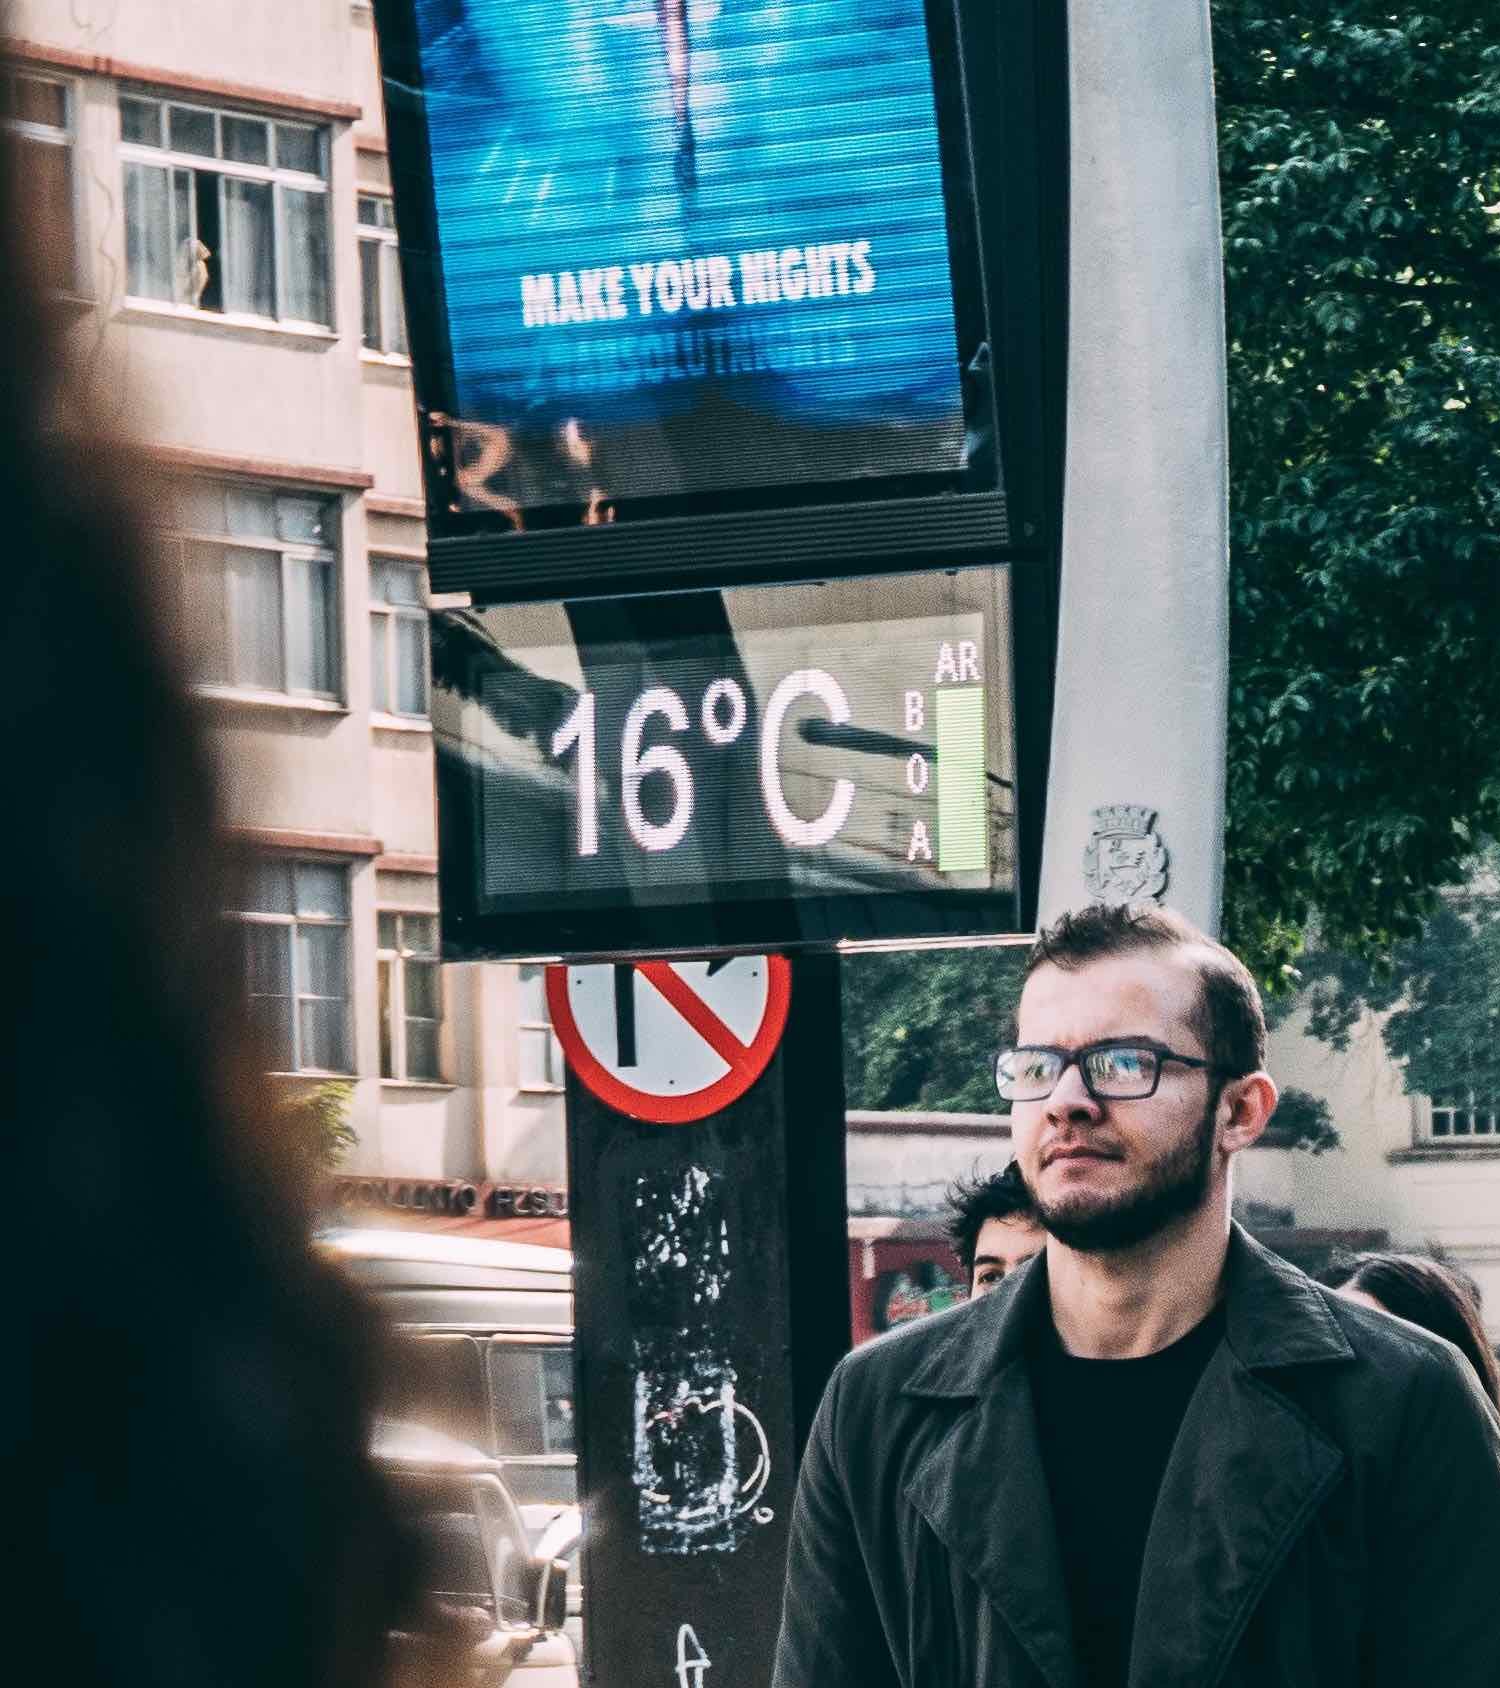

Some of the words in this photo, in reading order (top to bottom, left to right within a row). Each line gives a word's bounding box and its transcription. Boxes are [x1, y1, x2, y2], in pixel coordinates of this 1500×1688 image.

[521, 266, 628, 328] MAKE
[629, 255, 737, 315] YOUR
[738, 240, 876, 304] NIGHTS
[935, 640, 982, 684] AR
